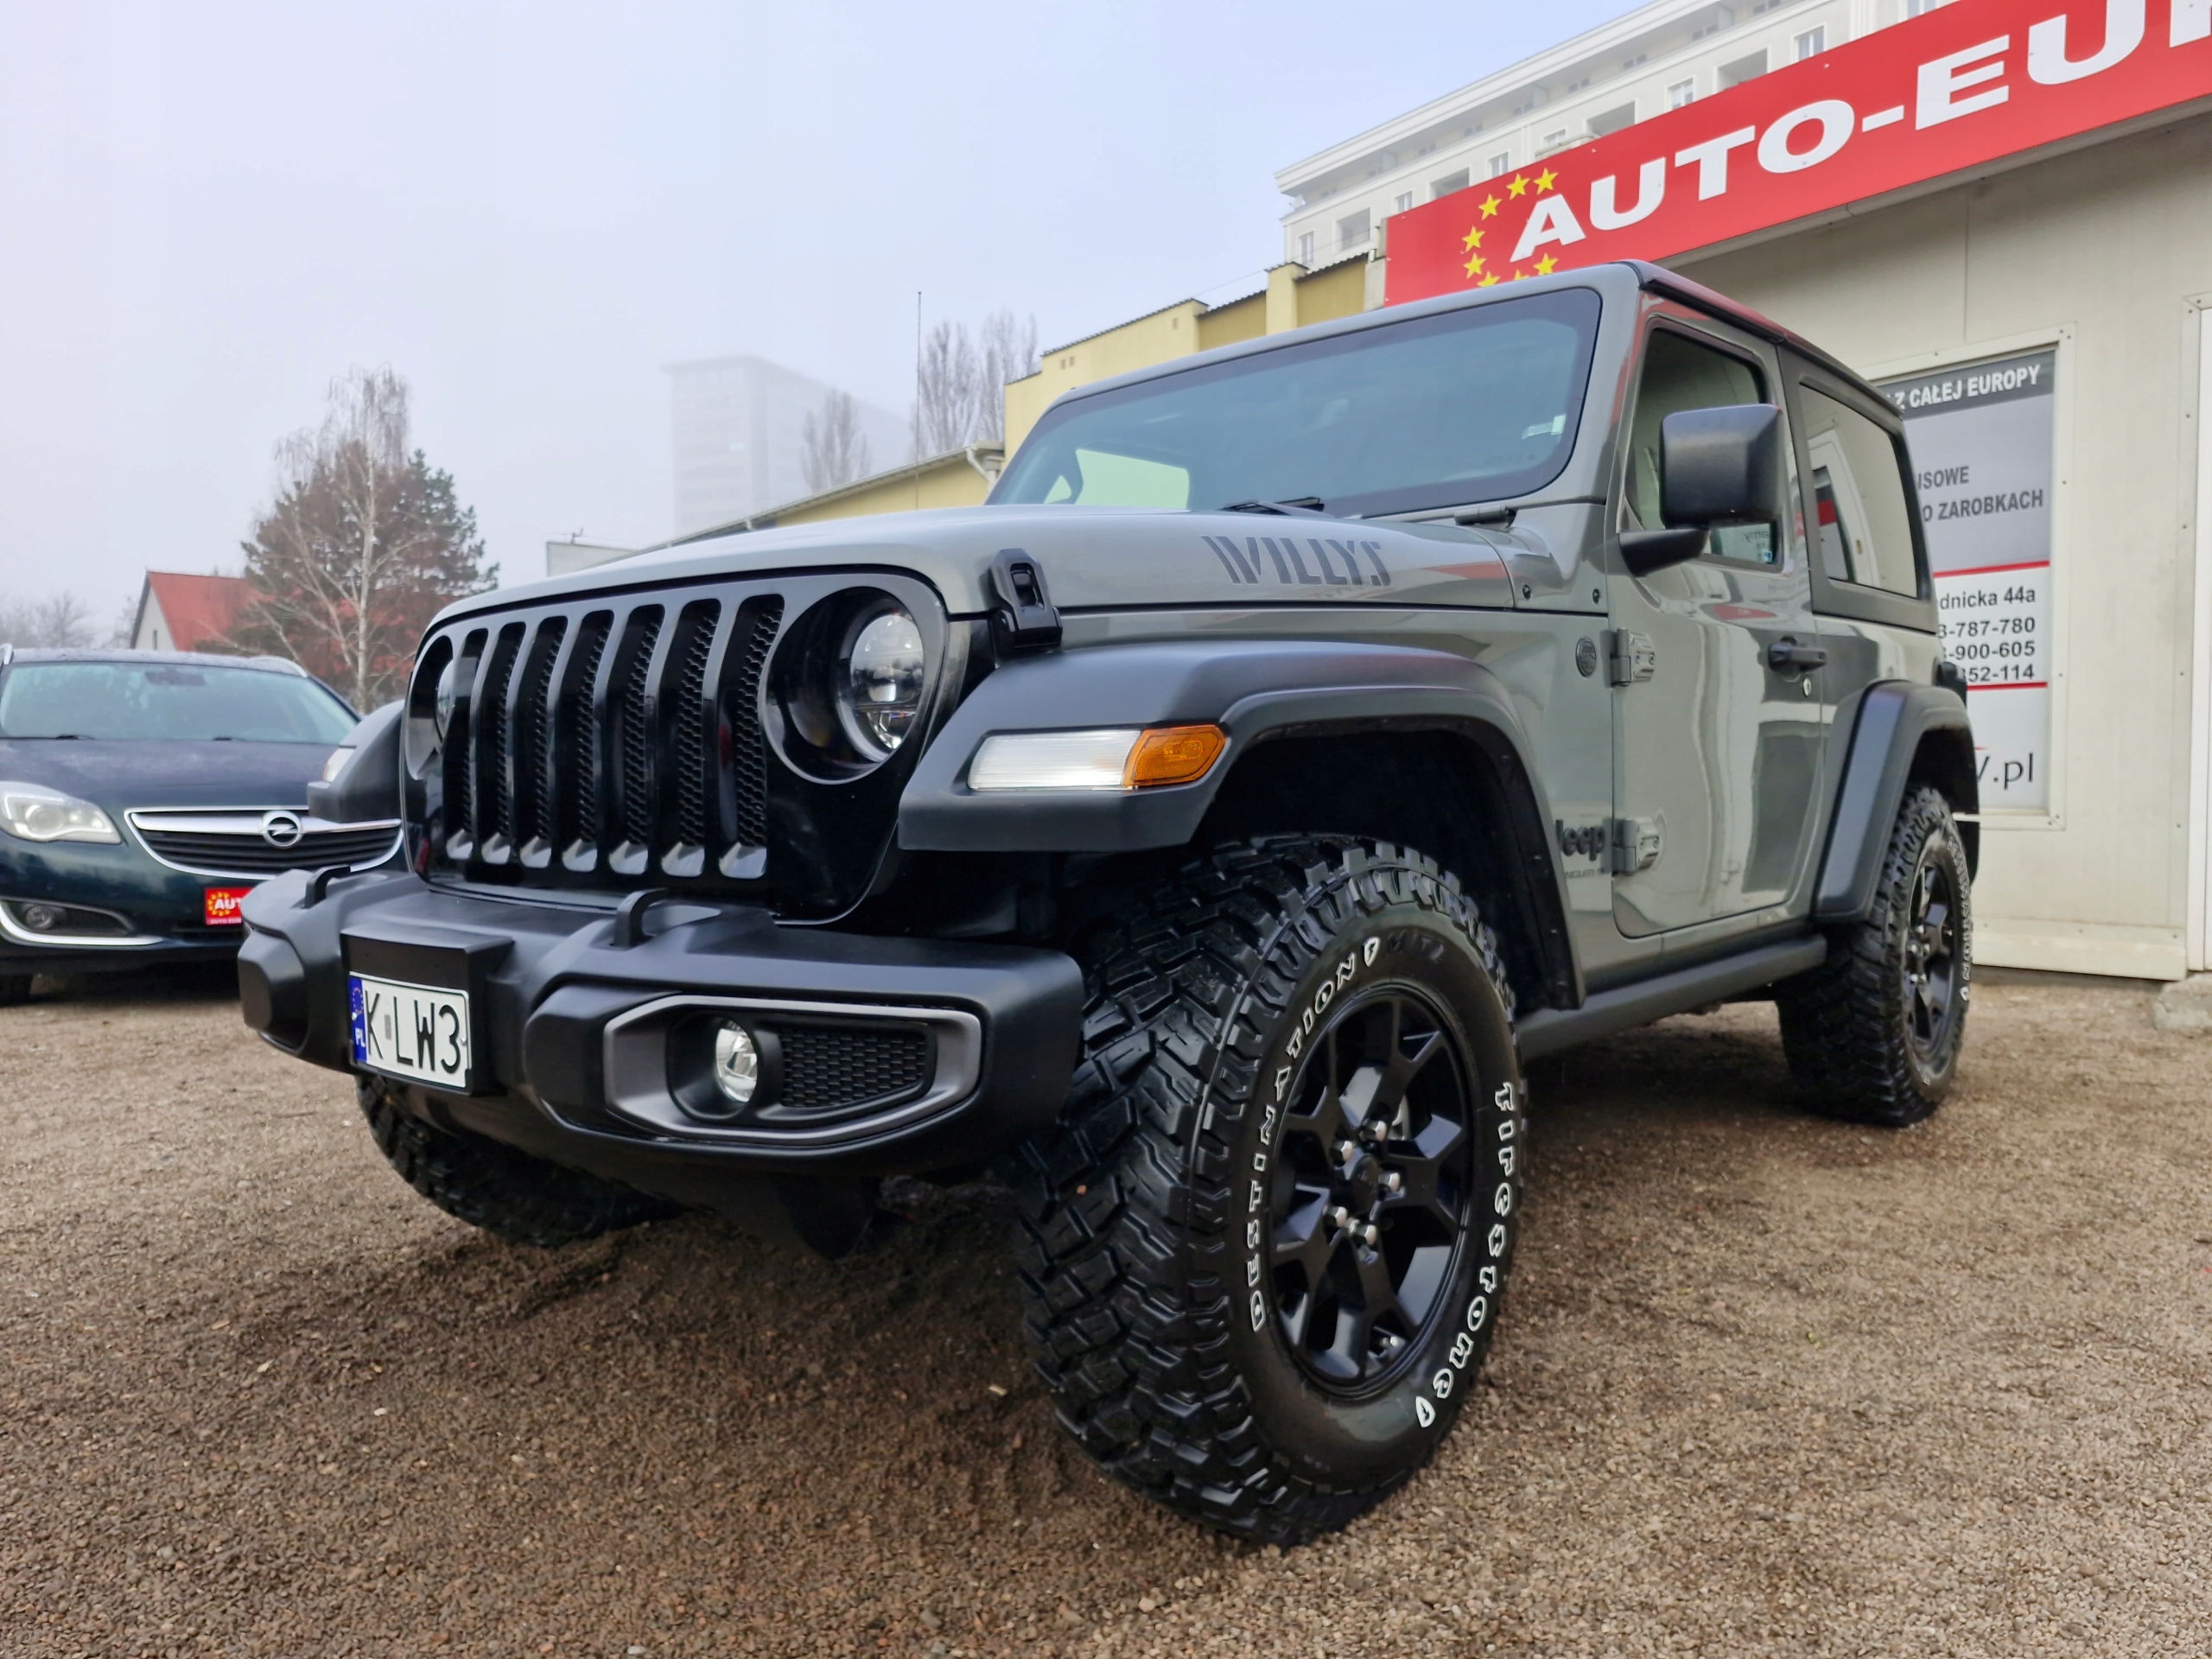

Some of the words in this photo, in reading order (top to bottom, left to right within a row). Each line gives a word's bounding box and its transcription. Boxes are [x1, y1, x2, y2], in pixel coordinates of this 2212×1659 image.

[1909, 379, 1963, 408] CAŁEJ
[1967, 364, 2042, 397] EUROPY
[1938, 489, 2044, 521] ZAROBKACH
[1200, 535, 1391, 587] WILLYS
[1940, 589, 1998, 610] dnicka
[2004, 586, 2036, 604] 44a
[355, 1027, 365, 1048] PL
[1248, 952, 1356, 1332] DESTINATION
